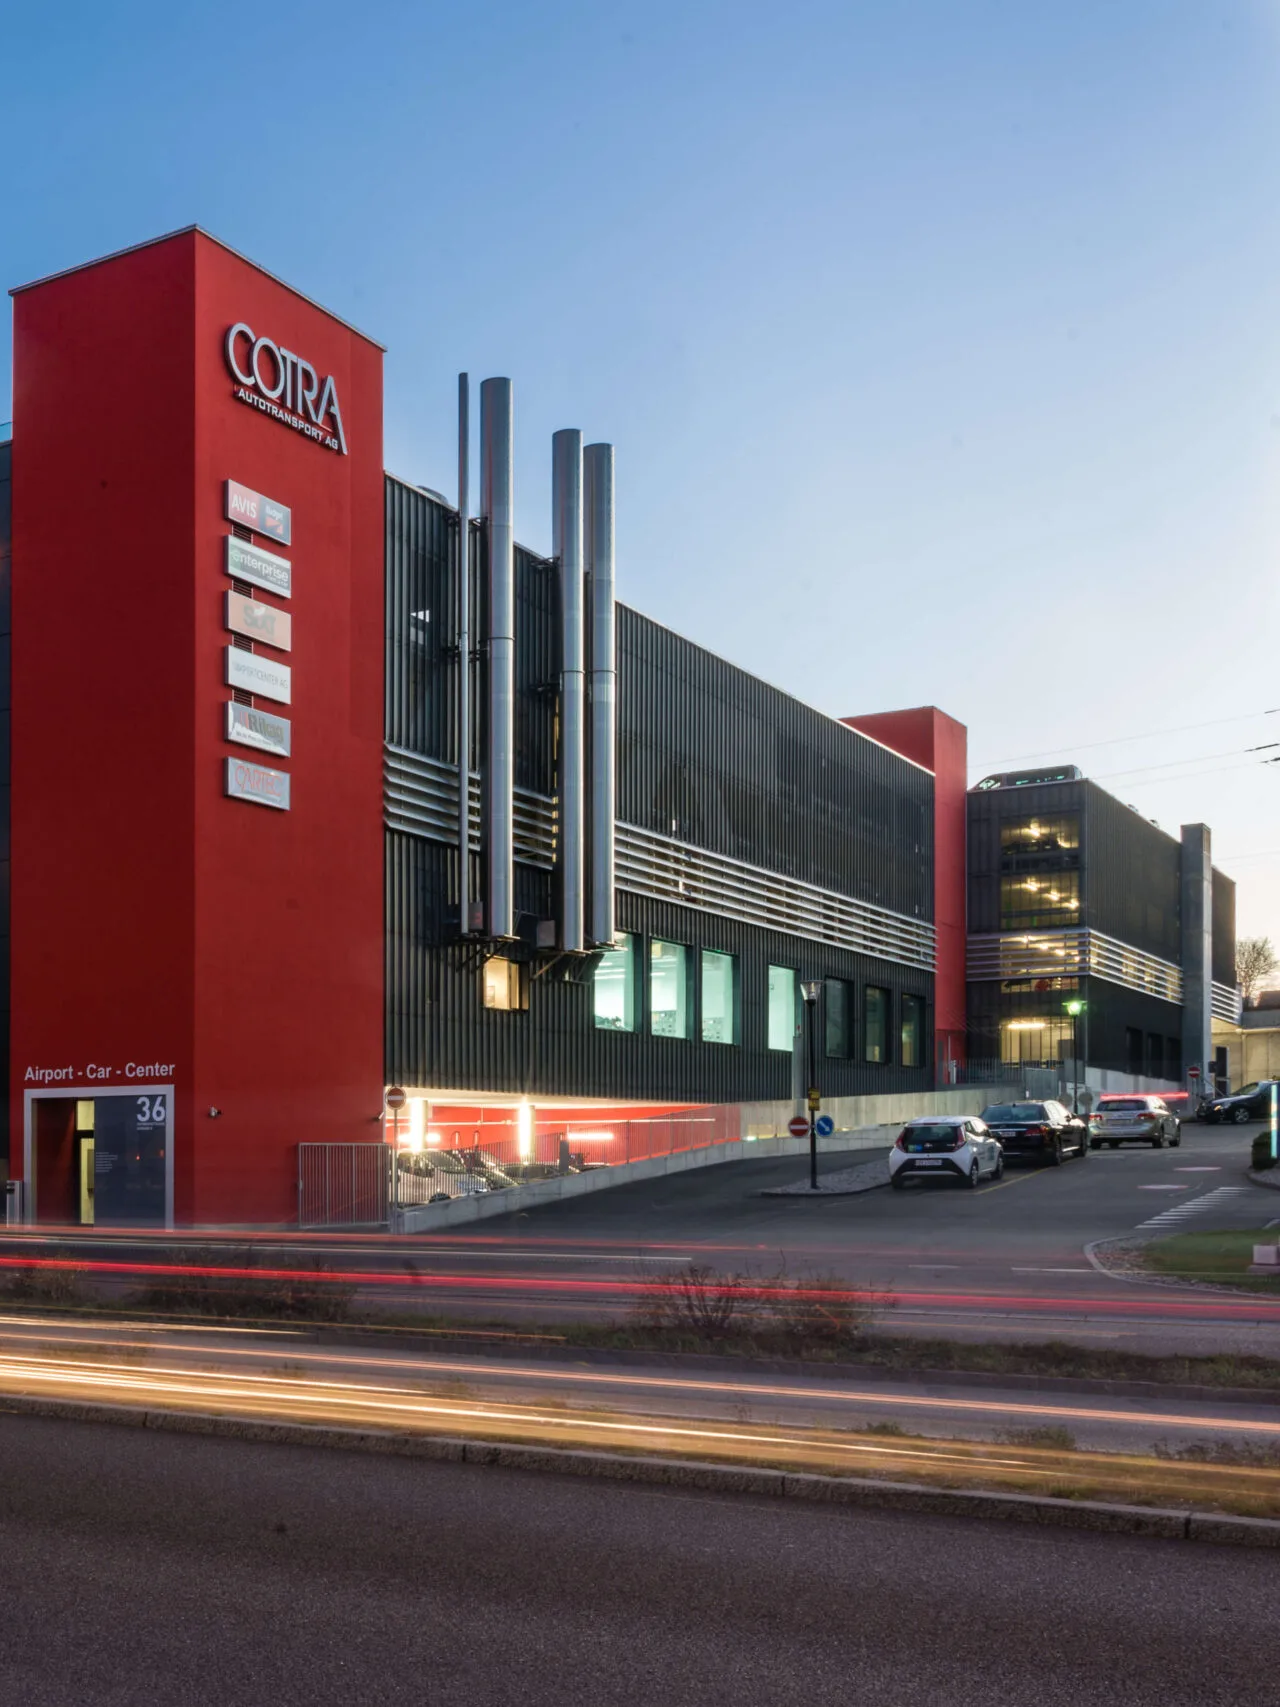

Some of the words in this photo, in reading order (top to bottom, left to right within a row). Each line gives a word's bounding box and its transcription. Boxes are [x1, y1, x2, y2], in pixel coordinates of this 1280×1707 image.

[225, 322, 348, 455] COTRA
[237, 388, 323, 441] AUTOTRANSPORT
[325, 435, 338, 450] AG
[231, 494, 257, 519] AVIS
[231, 550, 289, 582] enterprise
[24, 1066, 74, 1083] Airport
[86, 1064, 112, 1079] Car
[125, 1062, 175, 1078] Center
[136, 1096, 166, 1122] 36
